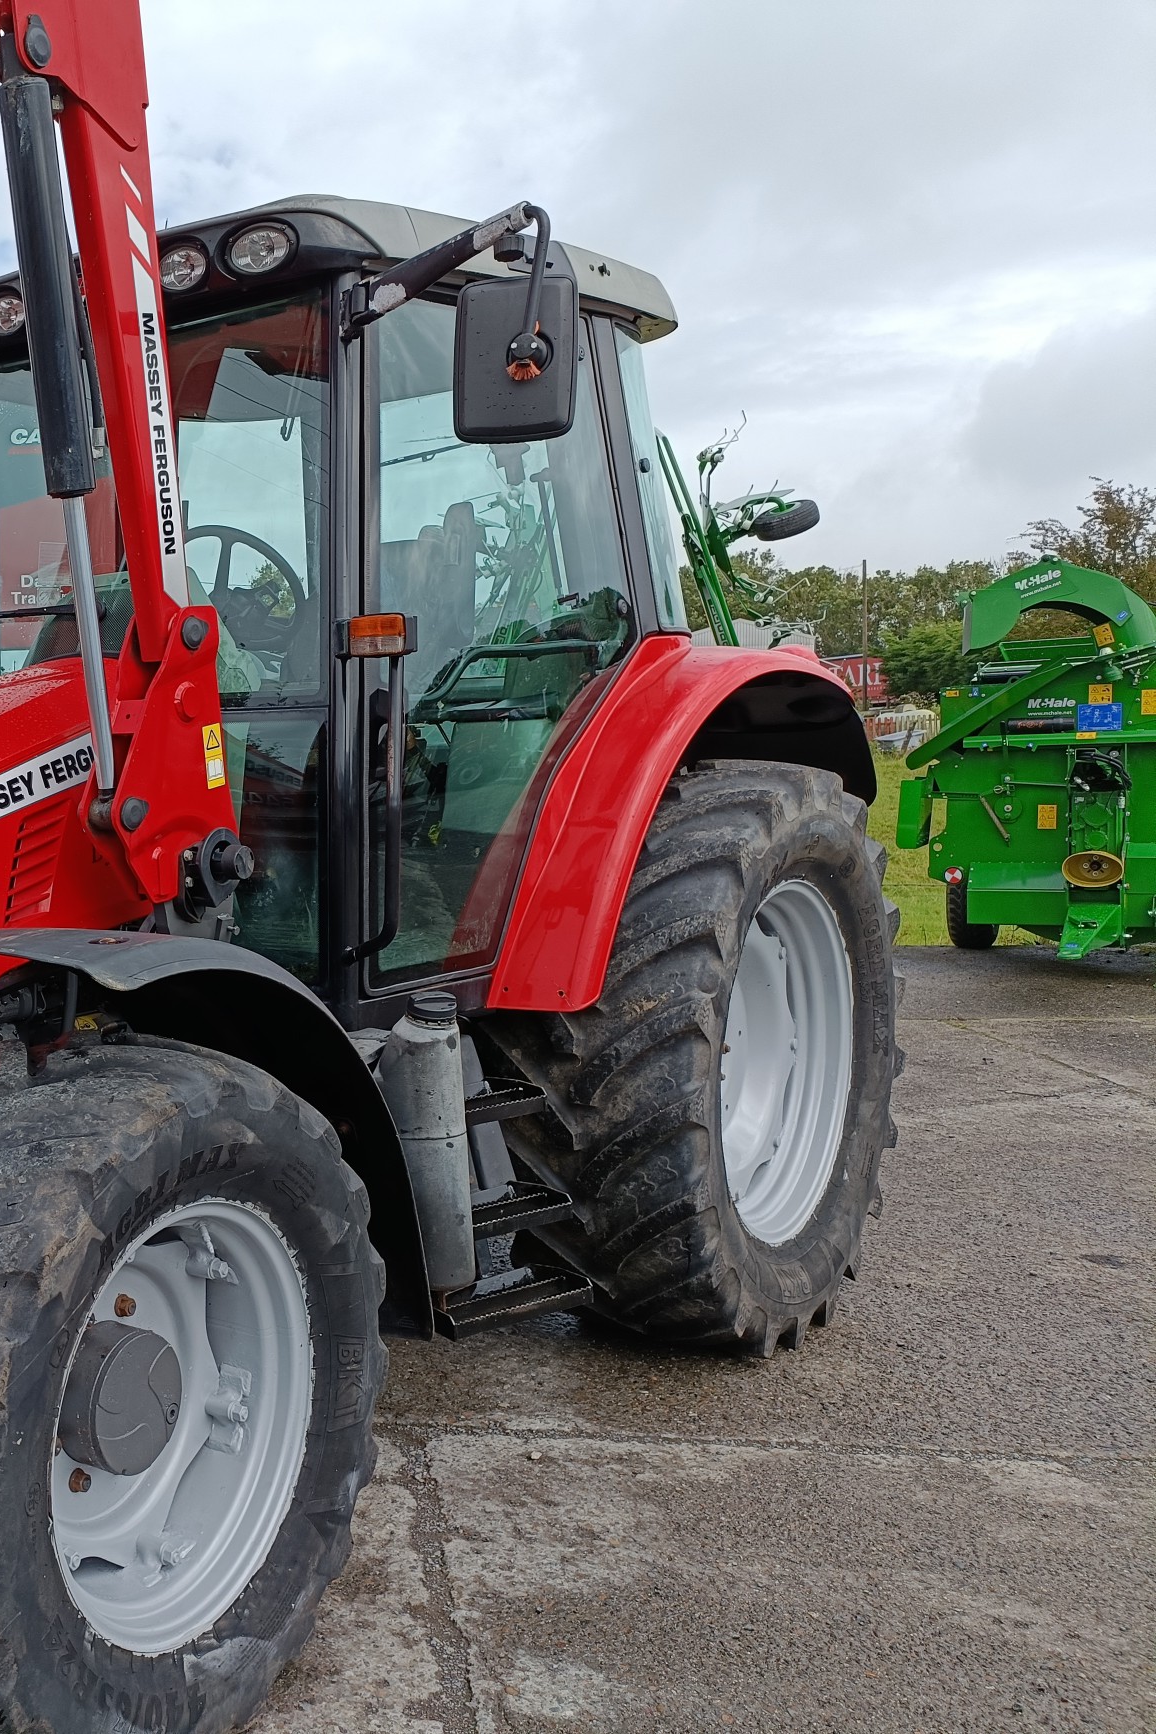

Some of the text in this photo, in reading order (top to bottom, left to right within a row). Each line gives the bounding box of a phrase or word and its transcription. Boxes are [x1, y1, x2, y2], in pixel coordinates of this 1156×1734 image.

[10, 428, 41, 445] CA
[141, 312, 177, 555] MASSEY FERGUSON
[1014, 568, 1062, 591] McHale
[1027, 697, 1076, 709] McHale
[857, 902, 890, 1058] AGRI MAX
[174, 1141, 247, 1188] MAX
[333, 1341, 366, 1420] BKT
